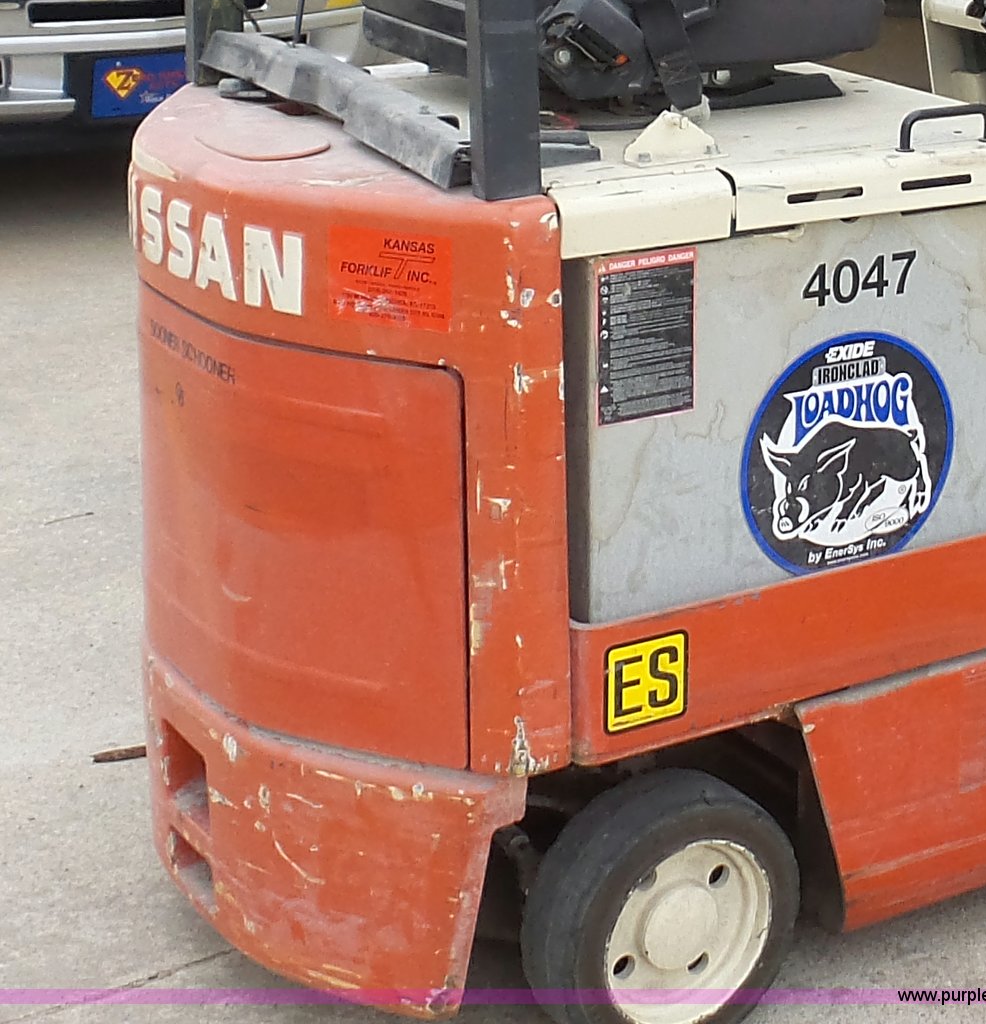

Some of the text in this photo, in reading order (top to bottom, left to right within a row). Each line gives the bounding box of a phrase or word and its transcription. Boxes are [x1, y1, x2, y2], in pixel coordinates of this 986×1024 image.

[129, 169, 304, 316] ISSAN
[383, 238, 436, 255] KANSAS
[608, 251, 694, 271] DANGER PELIGRO DANGER
[802, 249, 917, 307] 4047
[825, 340, 876, 363] EXIDE
[818, 359, 880, 385] IRONCLAD
[793, 376, 910, 446] LOADHOG
[807, 551, 822, 564] by
[824, 542, 864, 560] EnerSys
[866, 537, 887, 549] Inc.
[614, 645, 679, 718] ES
